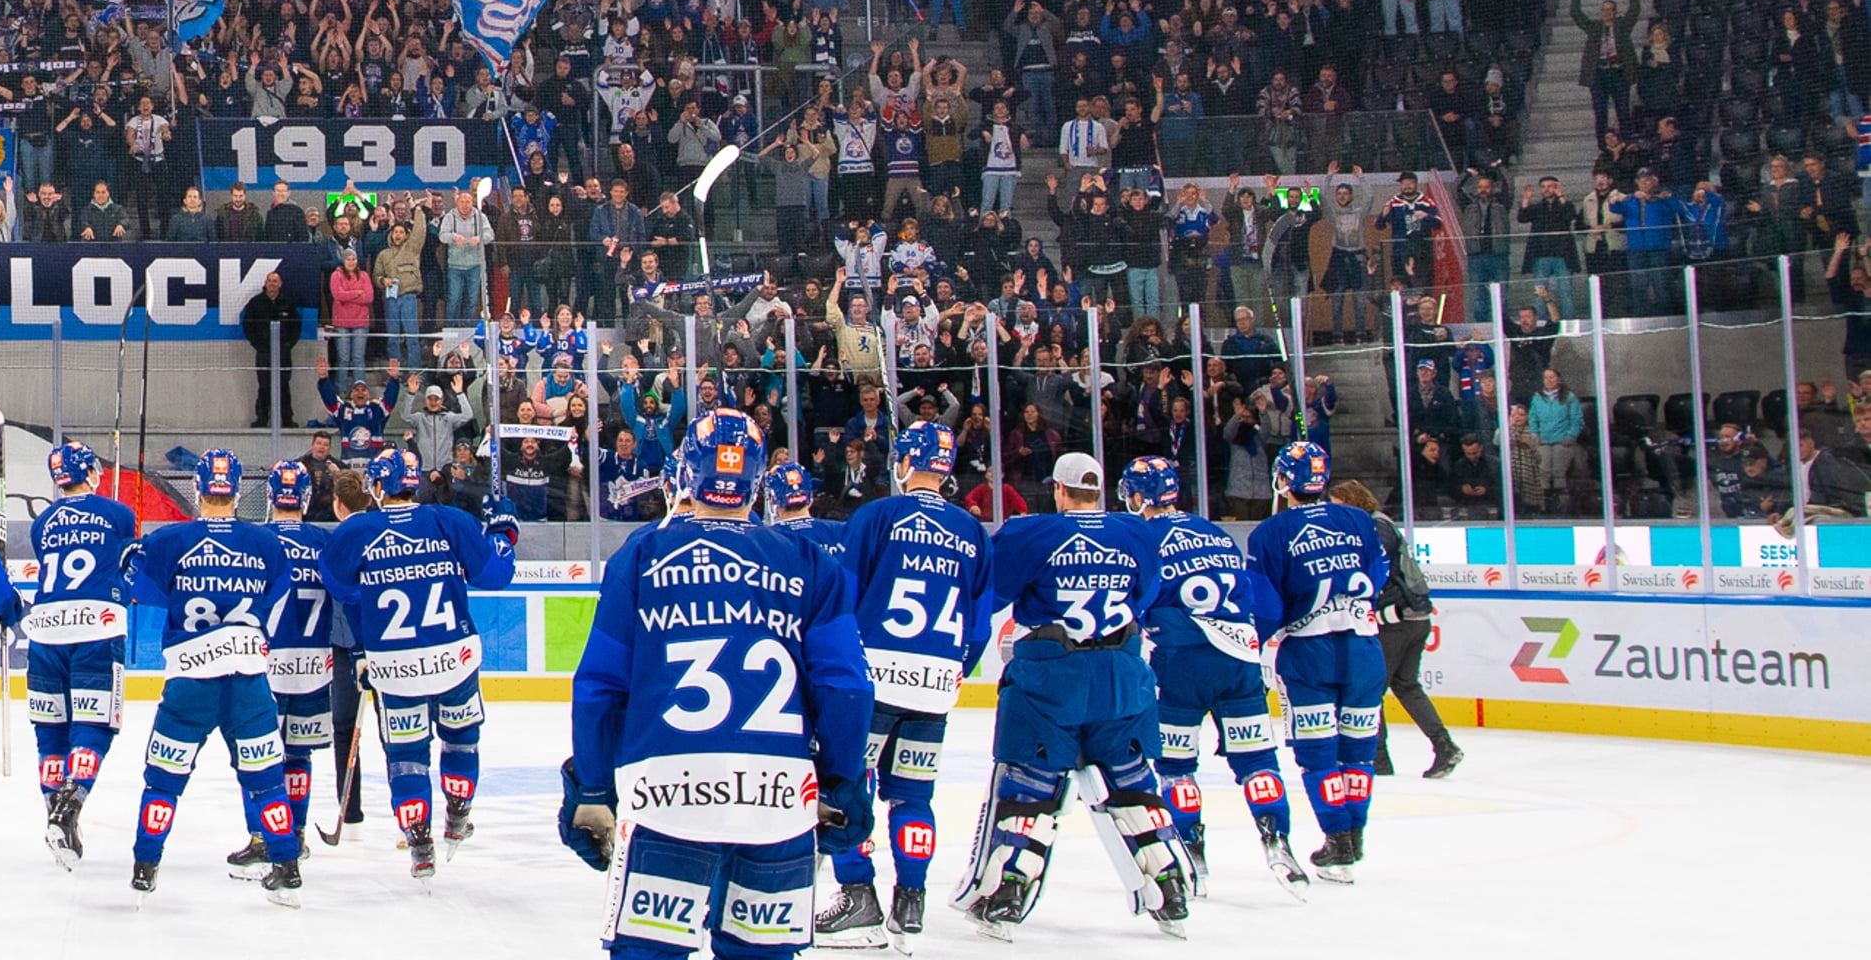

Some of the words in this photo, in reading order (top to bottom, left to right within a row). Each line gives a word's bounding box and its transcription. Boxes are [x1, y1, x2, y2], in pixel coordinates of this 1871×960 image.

[232, 125, 466, 184] 1930
[715, 480, 736, 491] 32
[706, 493, 742, 504] Adecco
[41, 529, 105, 550] SCHÄPPI
[362, 538, 450, 561] immoZins
[890, 524, 977, 559] immoZins
[179, 552, 265, 570] immoZins
[1760, 544, 1798, 561] SESH
[43, 549, 96, 593] 19
[903, 554, 959, 578] MARTI
[1304, 553, 1362, 576] TEXIER
[176, 576, 266, 594] TRUTMANN
[643, 557, 805, 597] immoZins
[1056, 575, 1131, 590] WAEBER
[1522, 571, 1578, 586] SwissLife
[1622, 573, 1676, 588] SwissLife
[1718, 574, 1772, 590] SwissLife
[1813, 575, 1865, 591] SwissLife
[183, 597, 261, 633] 86
[377, 581, 457, 640] 24
[639, 599, 803, 642] WALLMARK
[882, 578, 964, 648] 54
[1052, 590, 1133, 644] 35
[370, 652, 457, 679] SwissLife
[1594, 633, 1830, 689] Zaunteam
[662, 638, 804, 734] 32
[290, 720, 322, 735] ewz
[389, 713, 422, 730] ewz
[1297, 711, 1330, 728] ewz
[1341, 710, 1376, 727] ewz
[1228, 723, 1262, 739] ewz
[151, 740, 186, 762] ewz
[240, 740, 275, 758] ewz
[899, 747, 937, 768] ewz
[631, 771, 795, 811] SwissLife
[632, 890, 695, 924] ewz
[730, 898, 794, 926] ewz
